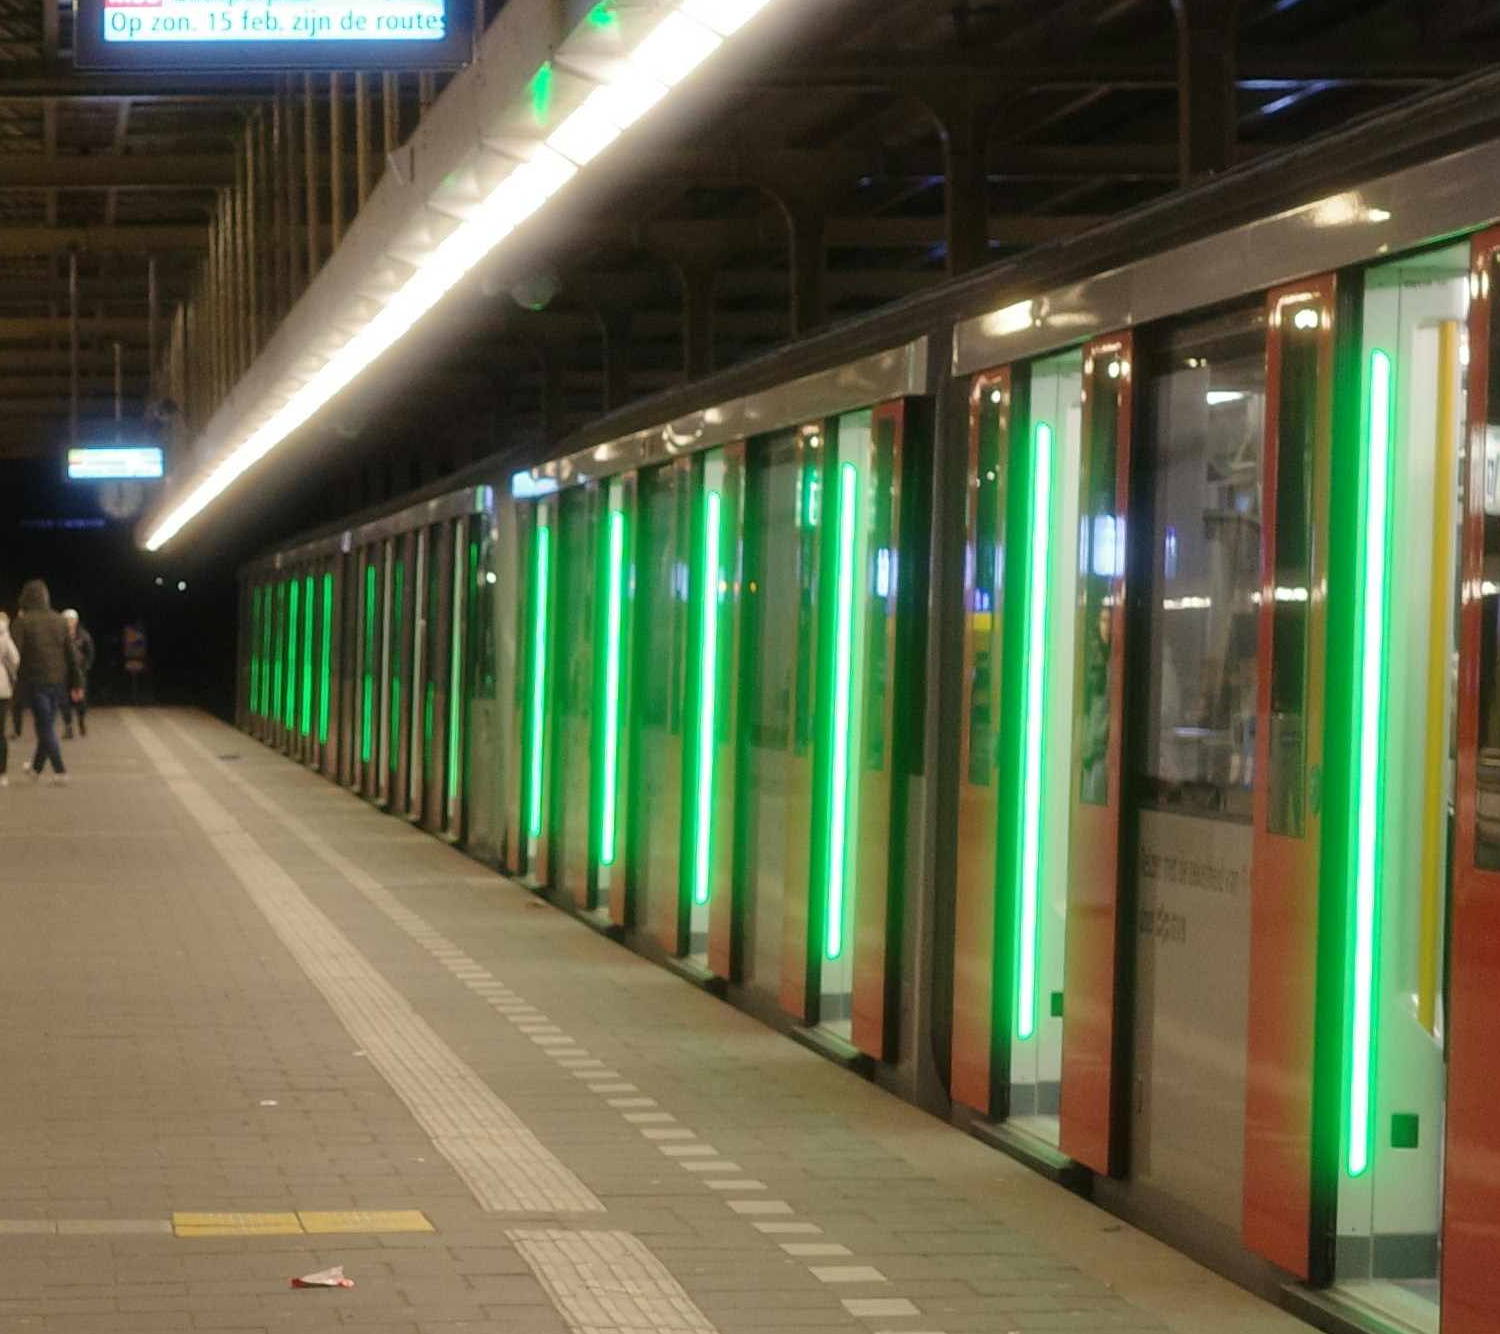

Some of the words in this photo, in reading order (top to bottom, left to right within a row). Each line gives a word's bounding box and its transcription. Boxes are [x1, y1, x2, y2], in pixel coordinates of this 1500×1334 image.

[111, 12, 142, 37] Op
[152, 16, 198, 31] zon.
[208, 12, 232, 31] 15
[242, 10, 284, 31] feb.
[292, 9, 331, 37] zijn
[340, 10, 367, 30] de
